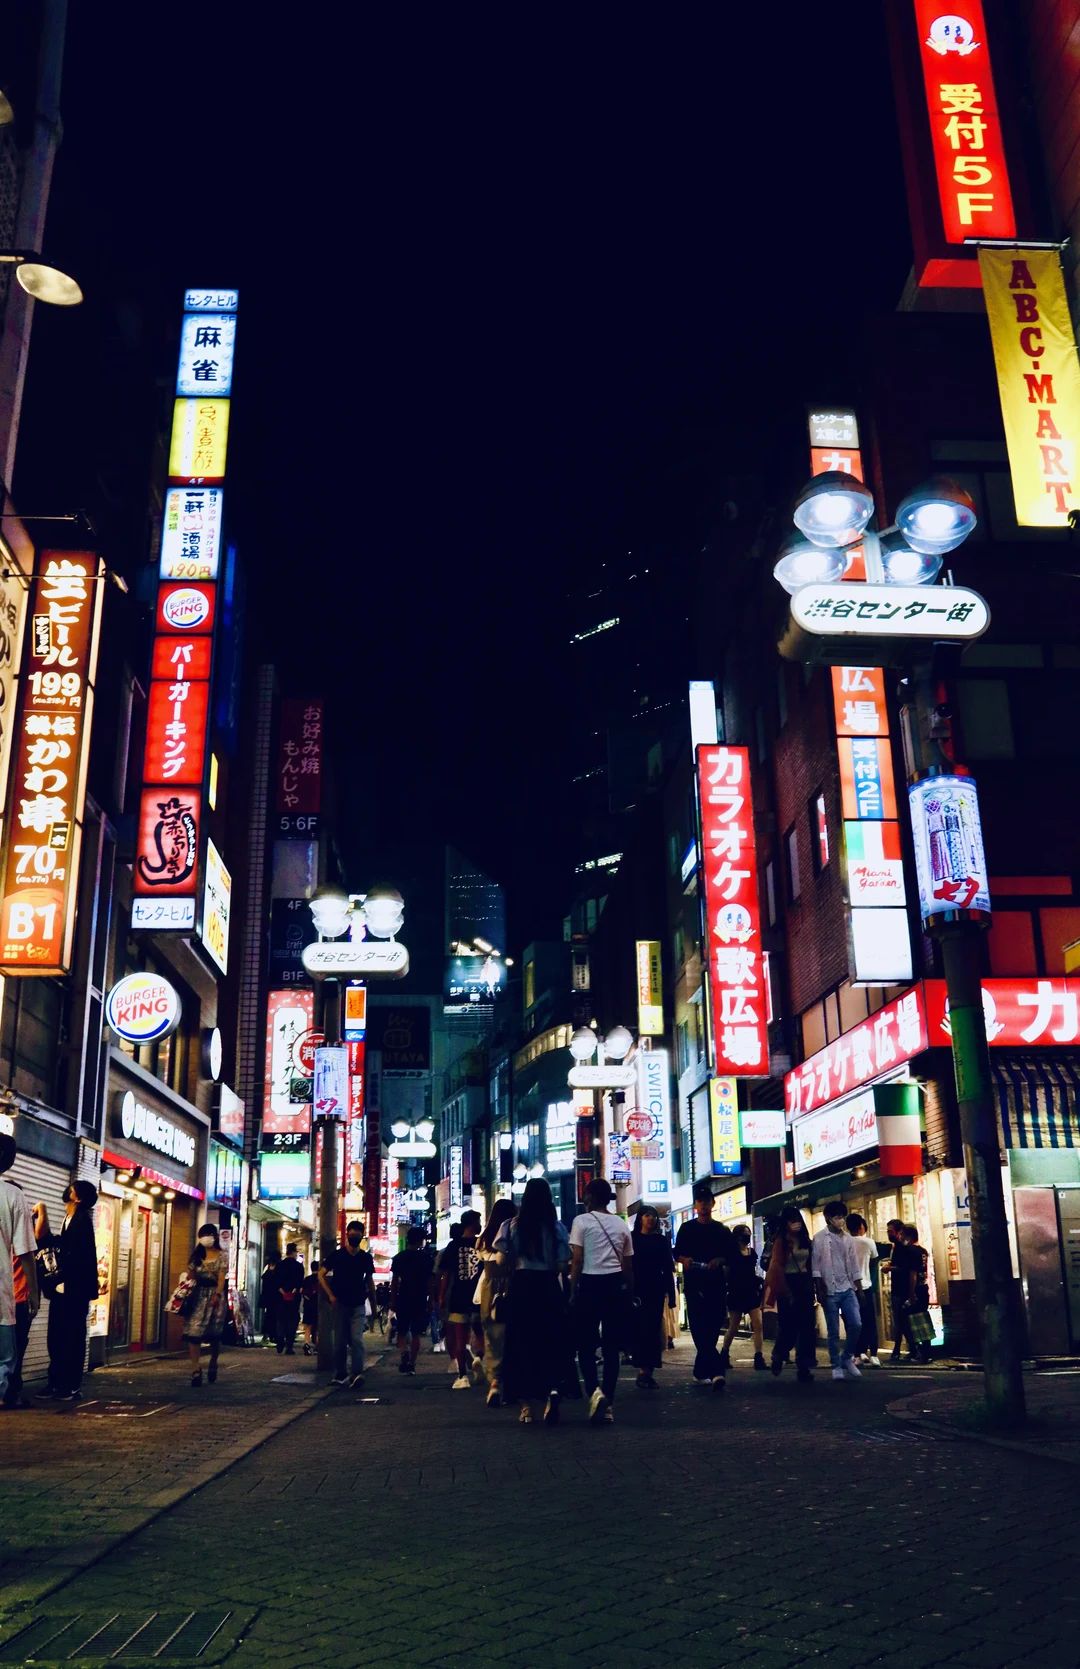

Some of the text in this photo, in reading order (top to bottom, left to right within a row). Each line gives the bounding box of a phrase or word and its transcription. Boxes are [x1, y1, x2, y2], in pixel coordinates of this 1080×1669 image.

[939, 83, 994, 225] 受付5F
[186, 294, 236, 306] センタービル
[192, 326, 222, 381] 麻雀
[1010, 260, 1071, 513] ABC-MART
[41, 559, 87, 666] 生ビール
[170, 597, 202, 609] BURGER
[170, 603, 203, 619] KING
[804, 599, 976, 622] 渋谷センター街
[28, 671, 81, 697] 199
[162, 644, 195, 778] バーガーキング
[300, 705, 321, 774] お好み焼
[281, 739, 299, 808] もんじゃ
[853, 741, 880, 817] 受付2F
[14, 845, 57, 875] 70
[287, 900, 302, 910] 4F
[933, 876, 980, 908] 七夕
[7, 902, 57, 940] B1
[134, 905, 193, 921] センタービル
[309, 951, 402, 963] 渋谷センター街
[282, 971, 304, 981] B1F
[115, 986, 167, 1010] BURGER
[117, 999, 168, 1025] KING
[786, 991, 921, 1119] カラオケ歌広場
[316, 1097, 338, 1114] 七夕
[648, 1063, 663, 1124] SWITCH
[628, 1119, 651, 1131] 消火栓
[717, 1102, 732, 1134] 松屋
[649, 1181, 666, 1191] B1F
